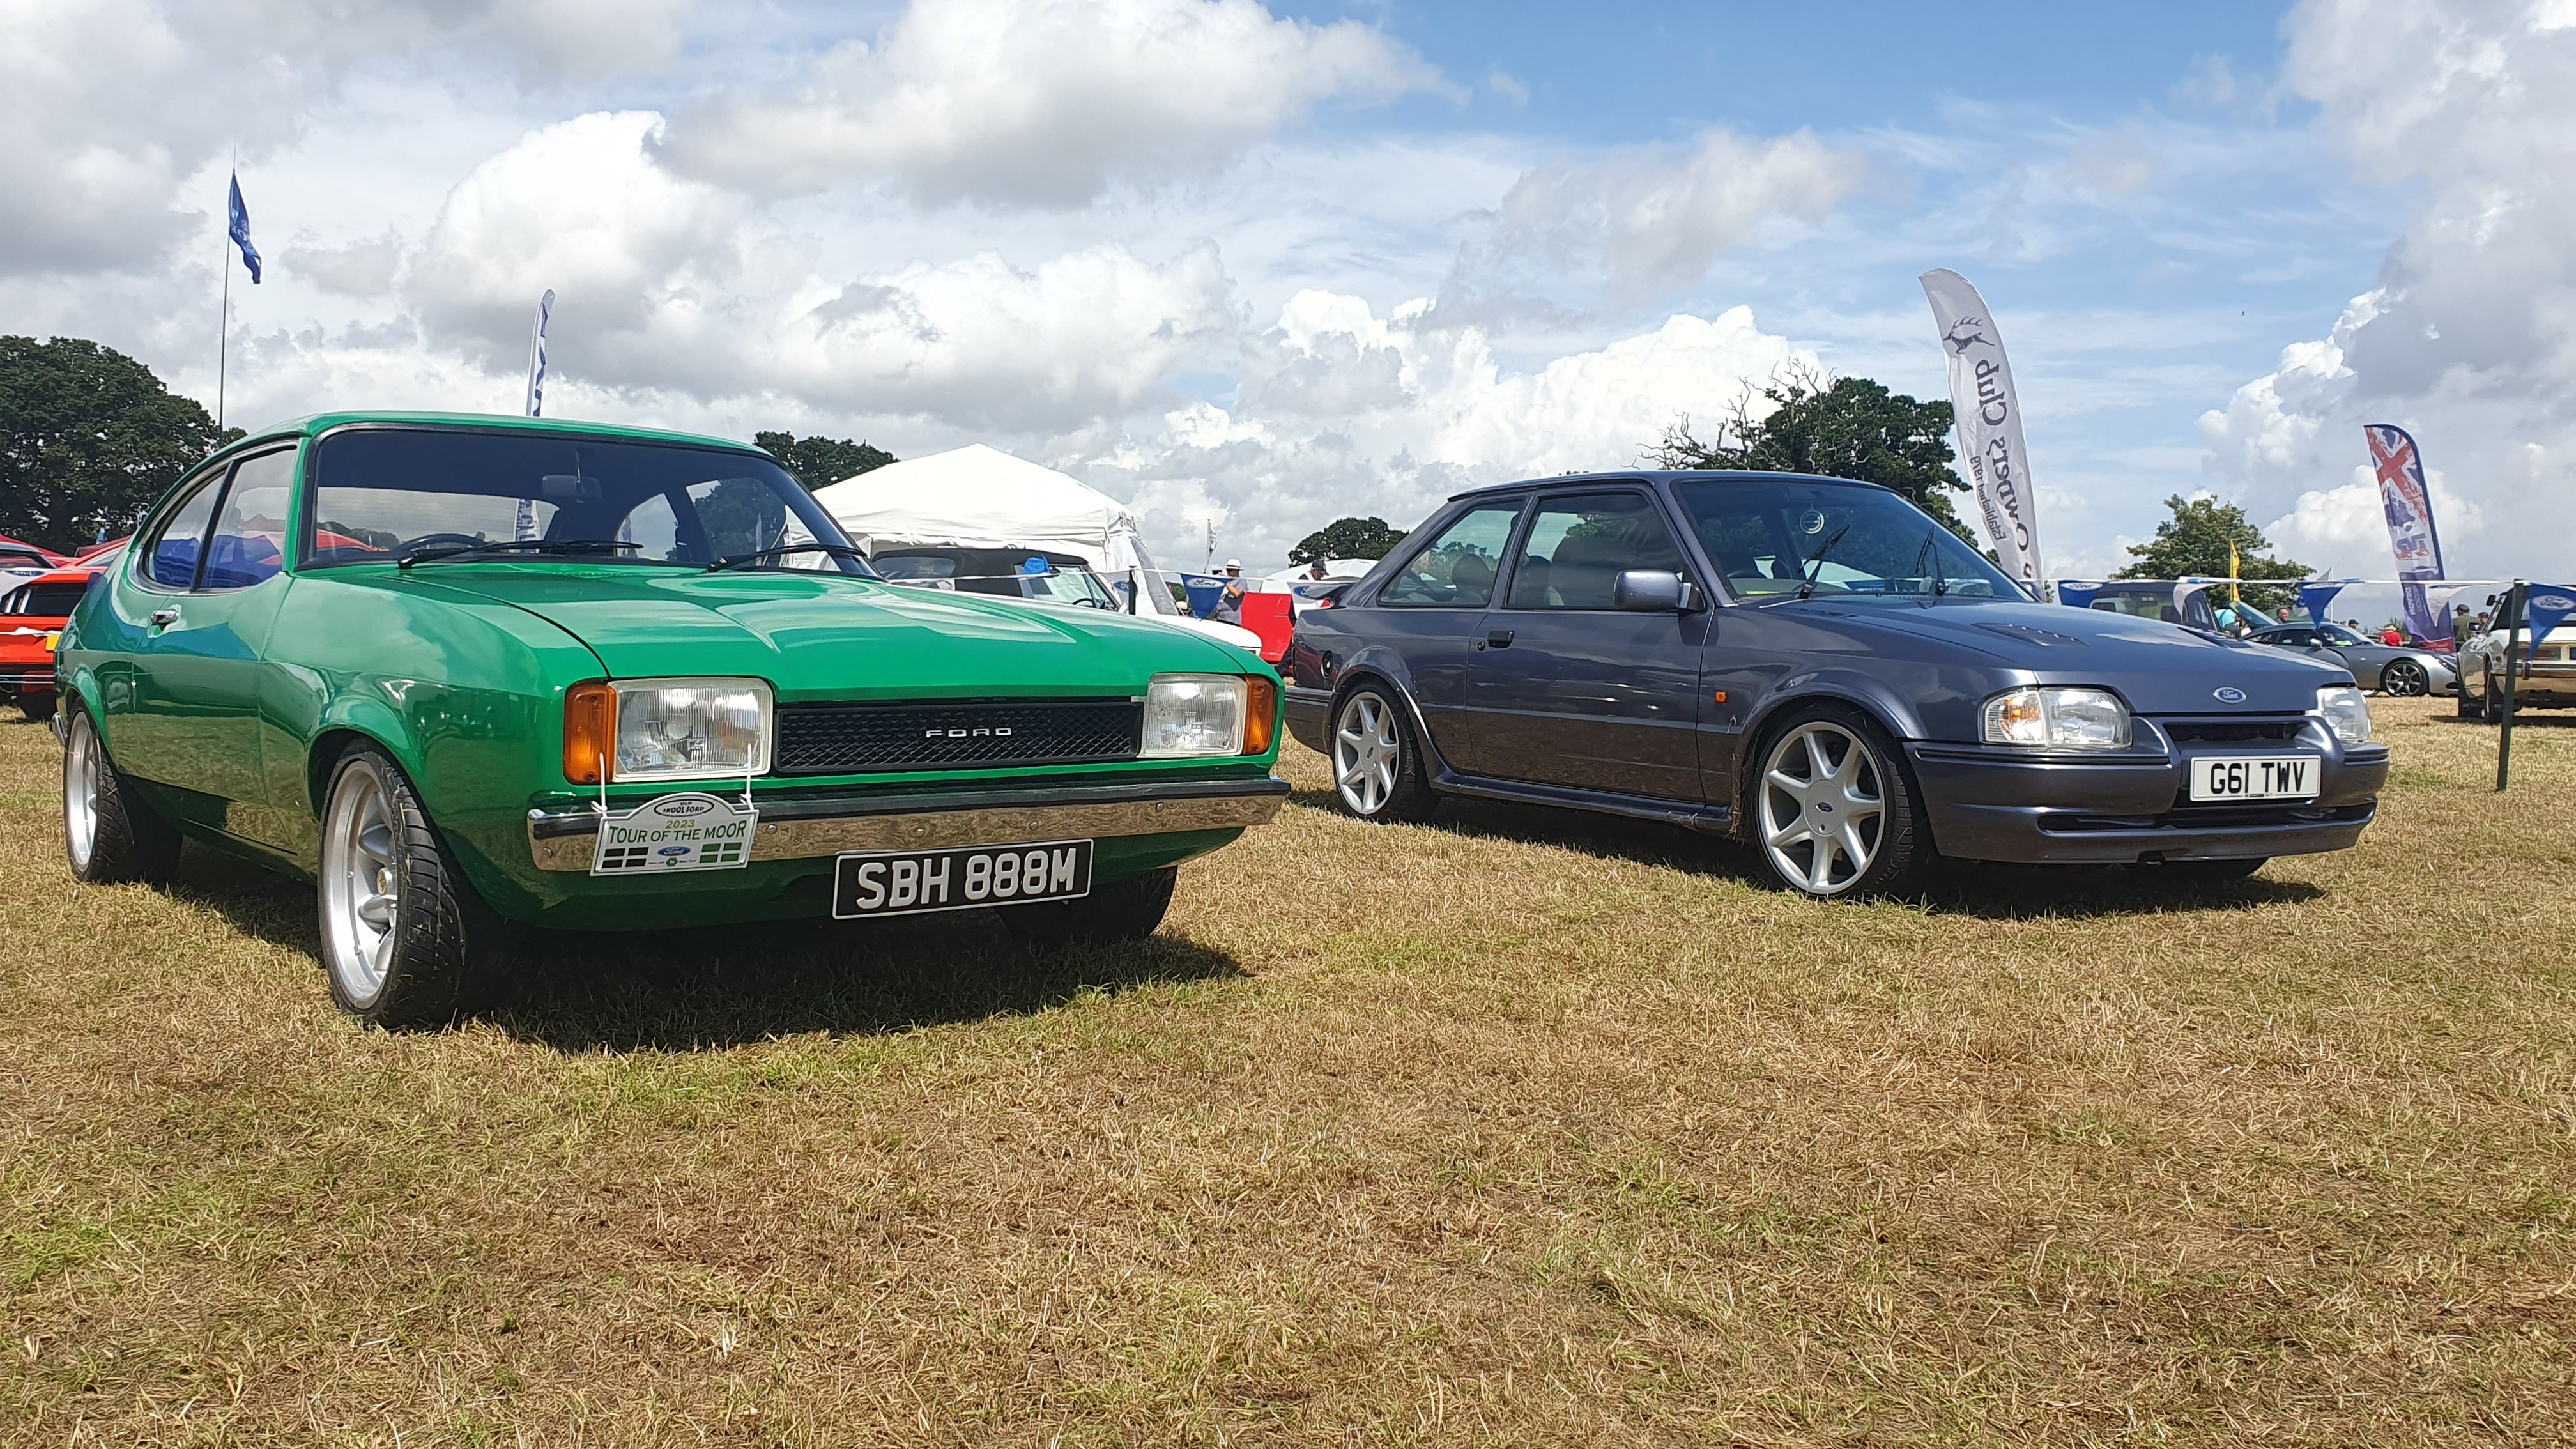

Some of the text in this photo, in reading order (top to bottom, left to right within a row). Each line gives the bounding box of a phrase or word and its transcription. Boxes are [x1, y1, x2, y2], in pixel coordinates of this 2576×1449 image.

[2540, 596, 2568, 608] Ford
[925, 727, 1012, 738] FORD
[2210, 761, 2306, 794] G61 TWV
[609, 820, 747, 844] TOUR OF THE MOOR
[665, 819, 696, 829] 2023
[855, 847, 1077, 910] SBH 888M
